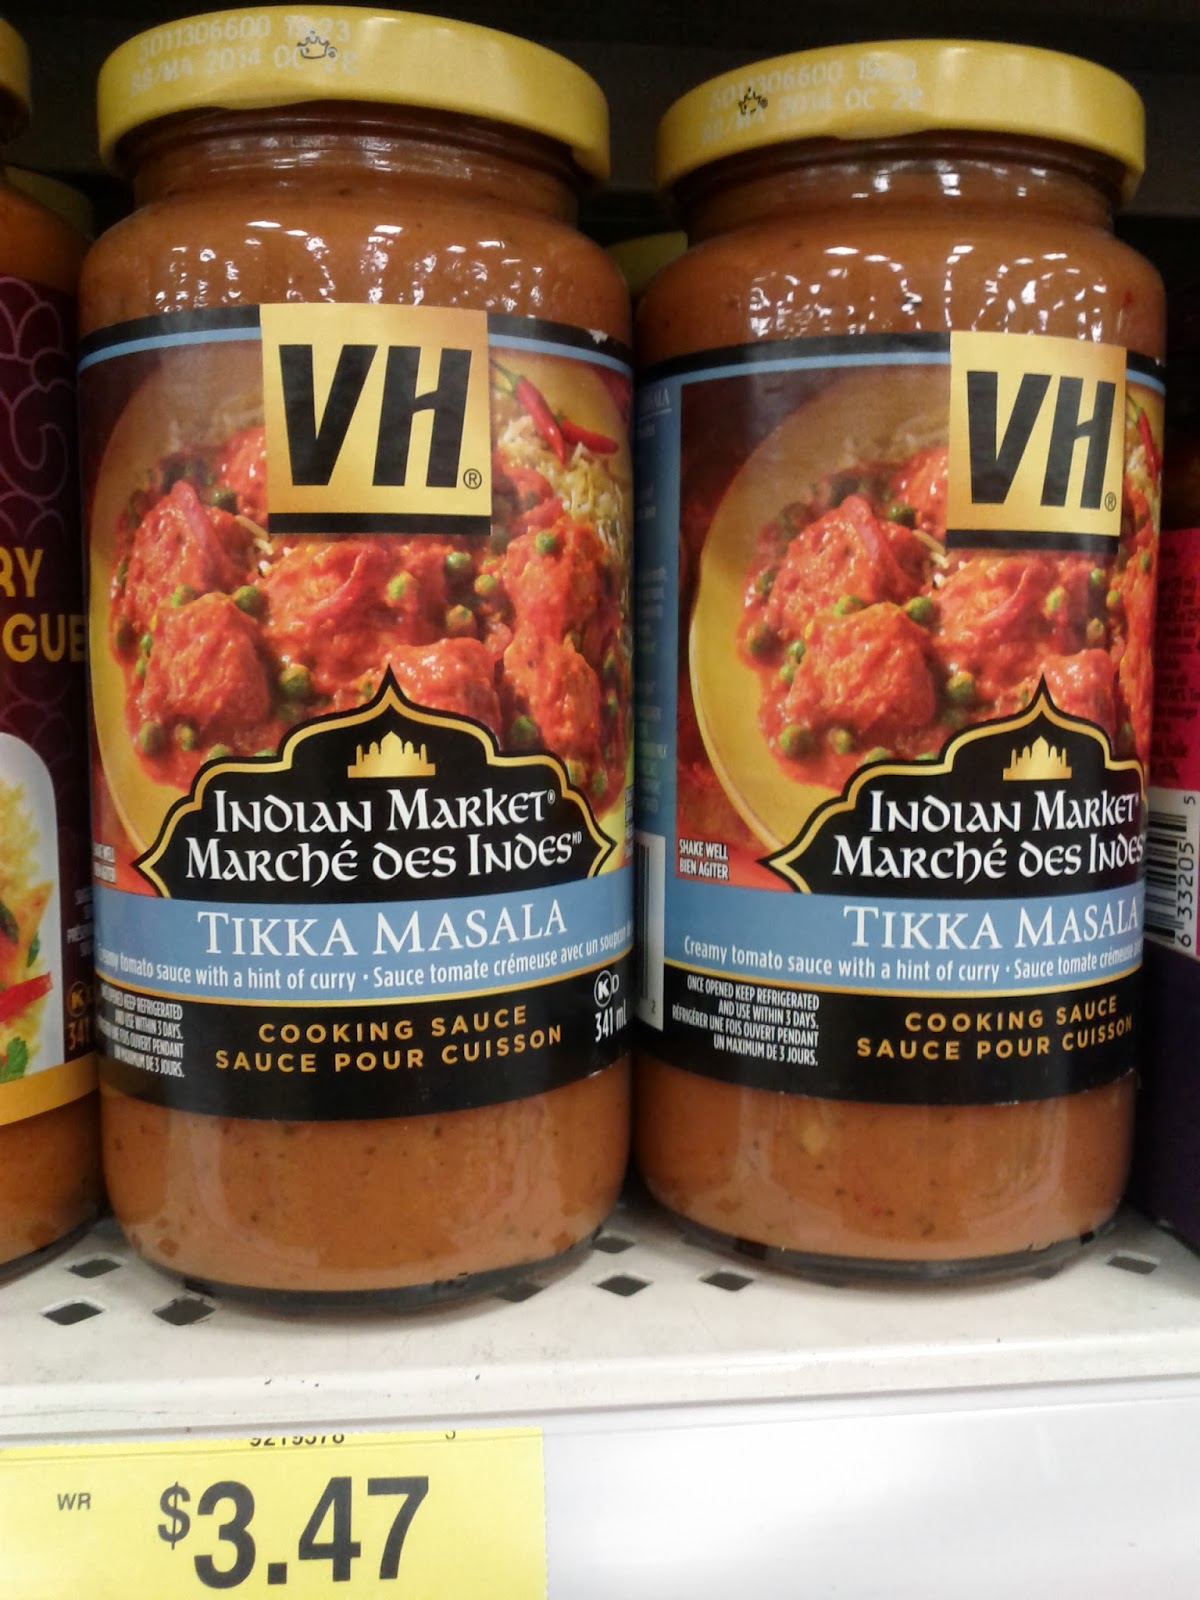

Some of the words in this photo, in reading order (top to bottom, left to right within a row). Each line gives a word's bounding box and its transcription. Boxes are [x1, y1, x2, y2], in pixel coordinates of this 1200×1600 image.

[279, 344, 472, 488] VH
[966, 371, 1116, 509] VH
[679, 838, 704, 856] SHAKE
[705, 842, 728, 860] WELL
[679, 857, 698, 874] BIEN
[698, 861, 729, 880] AGITER
[197, 911, 358, 957] TIKKA
[373, 899, 568, 955] MASALA
[843, 905, 1003, 950] TIKKA
[1015, 896, 1139, 949] MASALA
[120, 952, 154, 978] tomato
[156, 963, 192, 983] sauce
[196, 965, 229, 988] with
[233, 973, 243, 988] a
[248, 967, 281, 990] hint
[287, 968, 305, 990] of
[310, 971, 356, 993] curry
[373, 966, 425, 988] Sauce
[430, 959, 489, 983] tomate
[493, 952, 558, 976] crémeuse
[560, 945, 584, 965] avec
[586, 939, 598, 956] un
[684, 935, 728, 965] Creamy
[731, 944, 783, 970] tomato
[788, 955, 832, 976] sauce
[839, 957, 876, 980] with
[881, 963, 891, 980] a
[896, 959, 930, 981] hint
[936, 960, 954, 981] of
[958, 962, 999, 984] curry
[1014, 957, 1054, 979] Sauce
[1057, 952, 1098, 976] tomate
[136, 996, 183, 1020] REFRIGERATED
[687, 974, 704, 991] ONCE
[705, 978, 734, 998] OPENED
[735, 984, 755, 1002] KEEP
[757, 987, 820, 1011] REFRIGERATED
[258, 1020, 414, 1043] COOKING
[431, 1005, 527, 1037] SAUCE
[595, 1006, 613, 1043] 341
[672, 1002, 708, 1028] RÉFRIGÉRER
[709, 1014, 724, 1032] UNE
[725, 1019, 742, 1036] FOIS
[743, 1022, 775, 1042] OUVERT
[777, 1026, 819, 1047] PENDANT
[718, 1000, 734, 1016] AND
[736, 1002, 751, 1020] USE
[752, 1005, 784, 1025] WITHIN
[785, 1009, 791, 1026] 3
[793, 1011, 819, 1030] DAYS.
[904, 1009, 1043, 1033] COOKING
[1056, 995, 1117, 1026] SAUCE
[152, 1037, 184, 1058] PENDANT
[215, 1049, 317, 1073] SAUCE
[334, 1049, 424, 1072] POUR
[441, 1025, 562, 1064] CUISSON
[713, 1034, 725, 1050] UN
[726, 1036, 764, 1058] MAXIMUM
[766, 1044, 778, 1061] DE
[779, 1046, 785, 1062] 3
[786, 1047, 818, 1066] JOURS.
[856, 1037, 960, 1060] SAUCE
[976, 1036, 1050, 1059] POUR
[1062, 1014, 1132, 1051] CUISSON
[57, 1492, 92, 1511] WR
